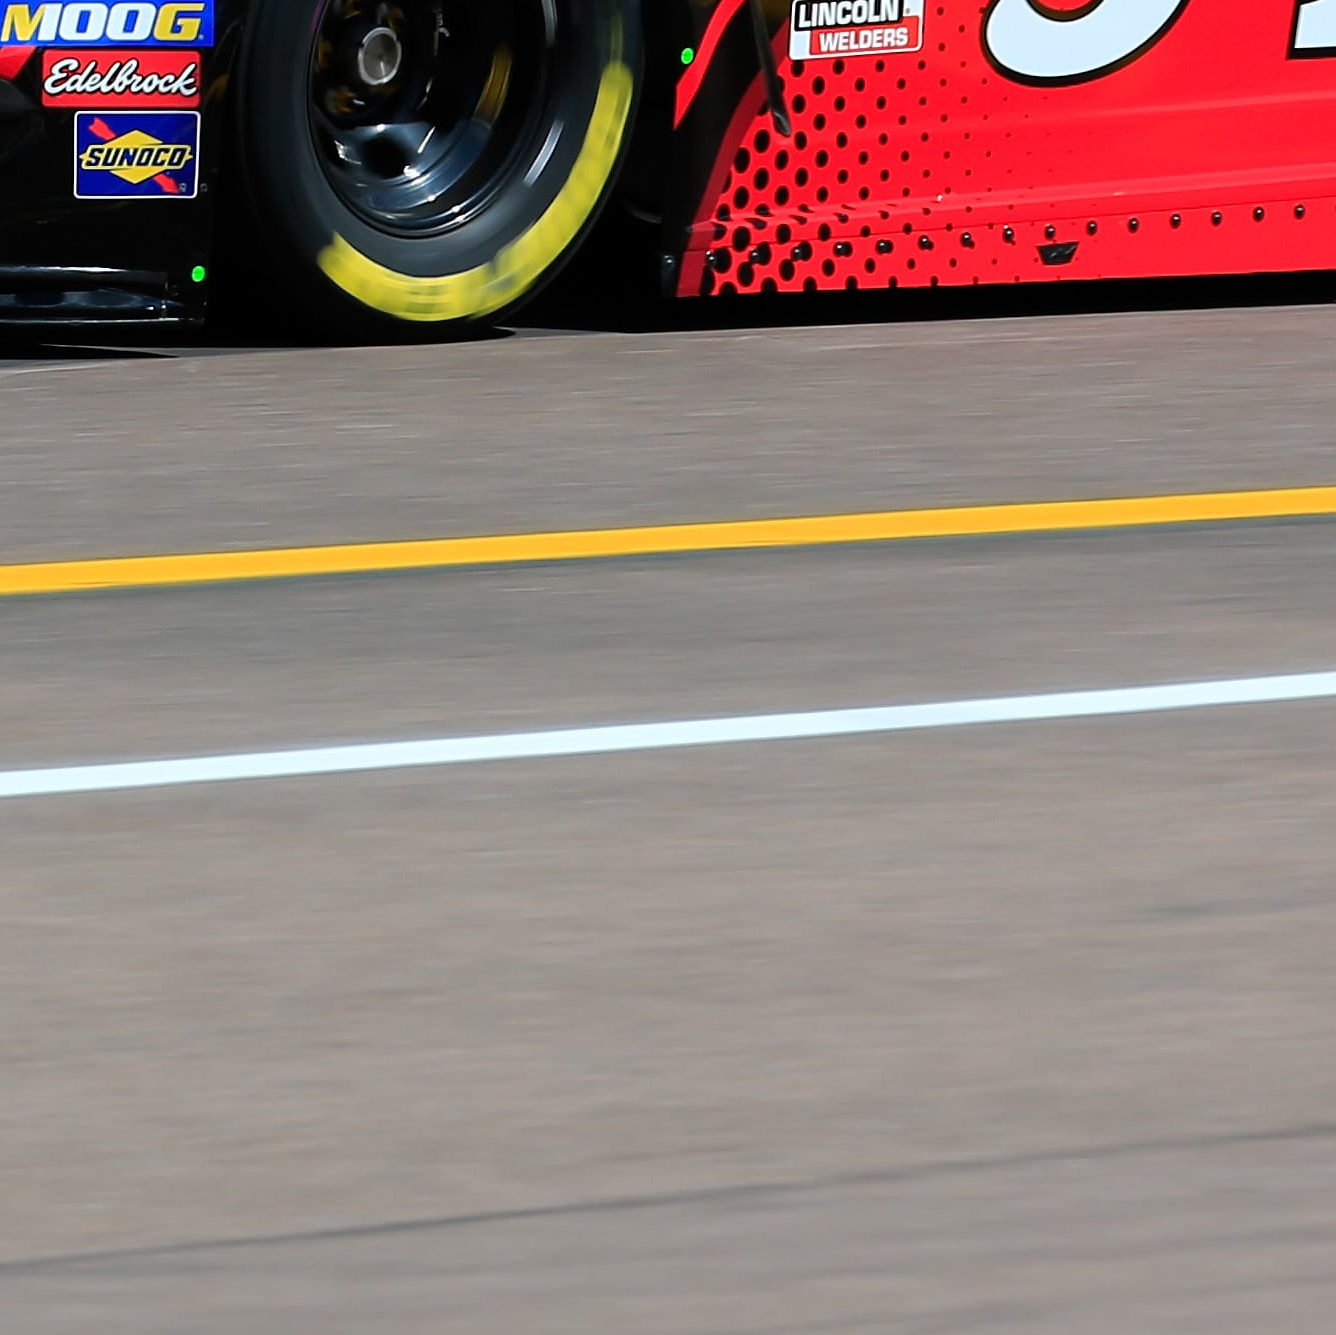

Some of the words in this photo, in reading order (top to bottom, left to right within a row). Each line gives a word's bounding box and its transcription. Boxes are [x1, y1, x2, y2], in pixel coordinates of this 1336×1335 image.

[0, 2, 205, 42] MOOG
[818, 27, 909, 53] WELDERS
[44, 58, 200, 97] Edelbrock
[86, 145, 190, 169] SUNOCO
